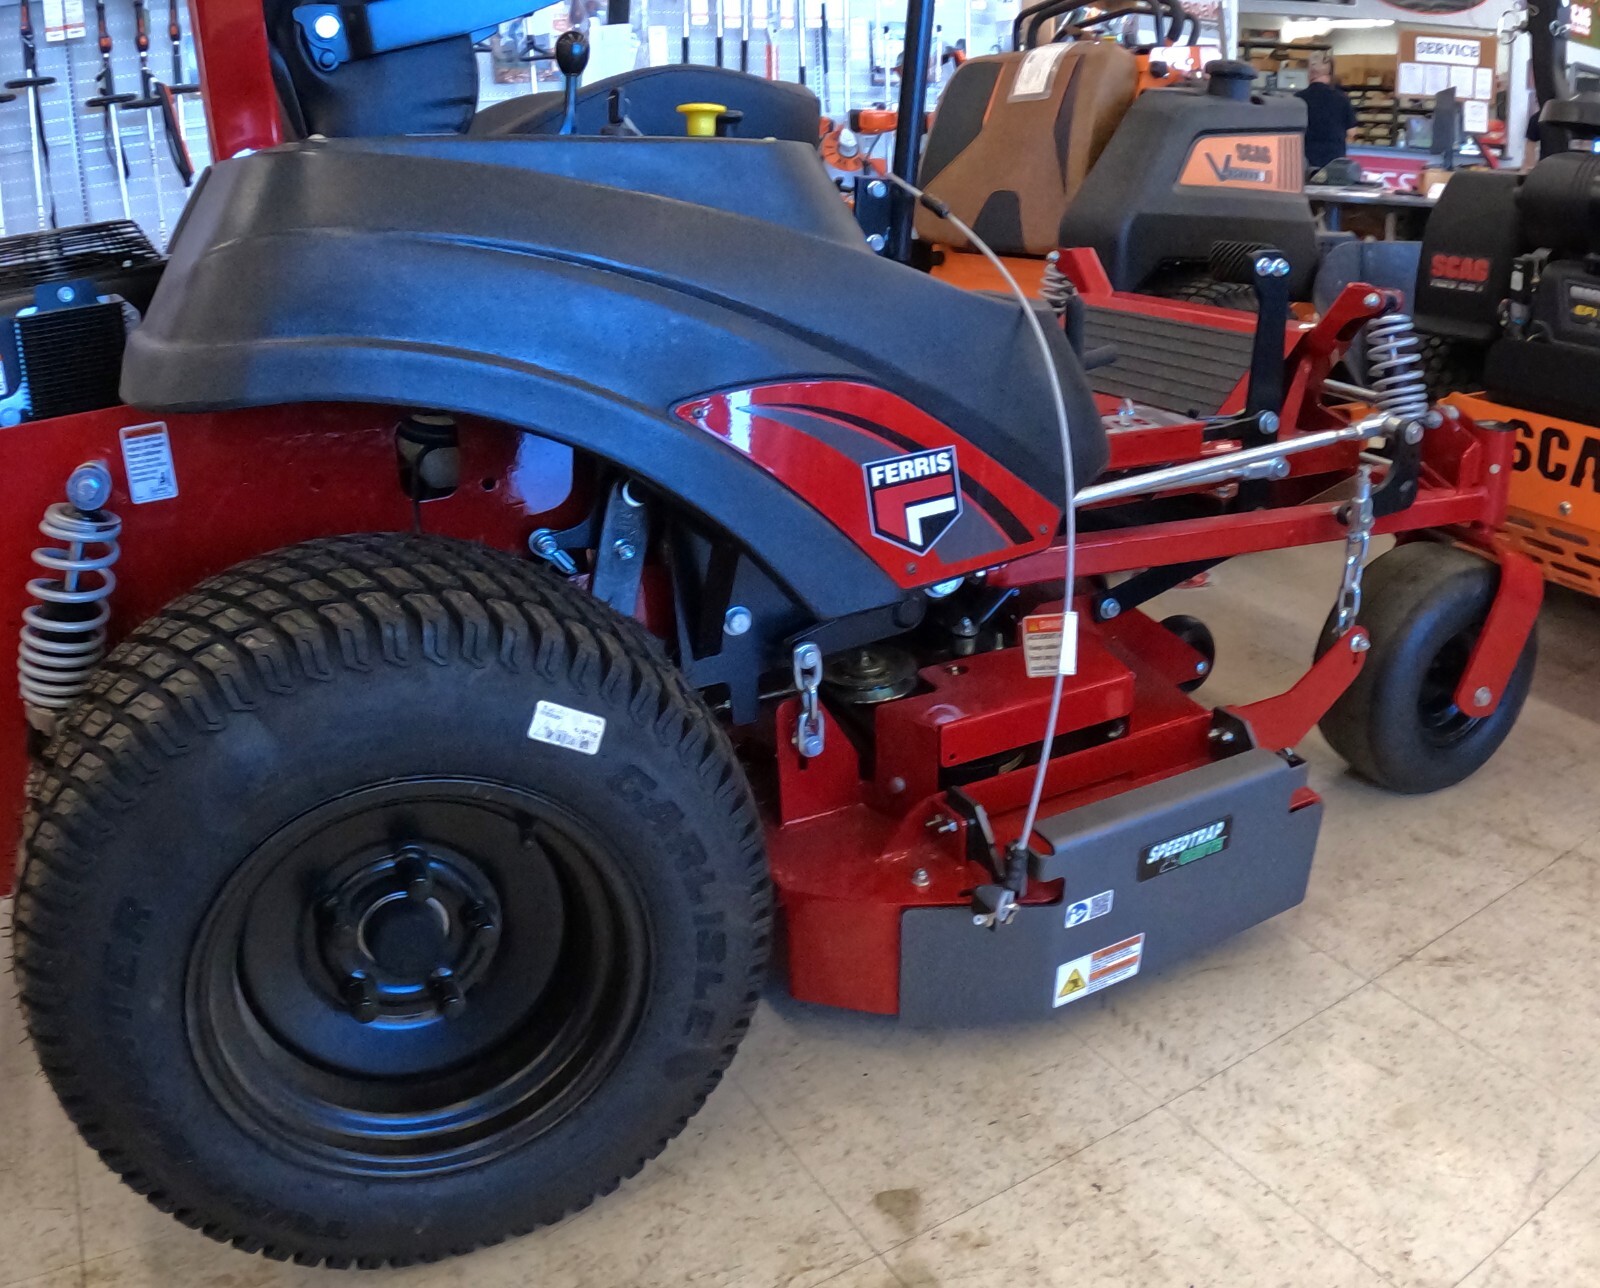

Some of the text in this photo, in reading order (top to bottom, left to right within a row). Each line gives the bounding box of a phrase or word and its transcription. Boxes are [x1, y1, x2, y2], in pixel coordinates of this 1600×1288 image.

[1416, 41, 1480, 58] SERVICE
[1431, 254, 1490, 282] SCAG
[870, 452, 952, 487] FERRIS
[1145, 821, 1225, 865] SPEEDTRAP
[606, 763, 728, 1039] CARLISLE
